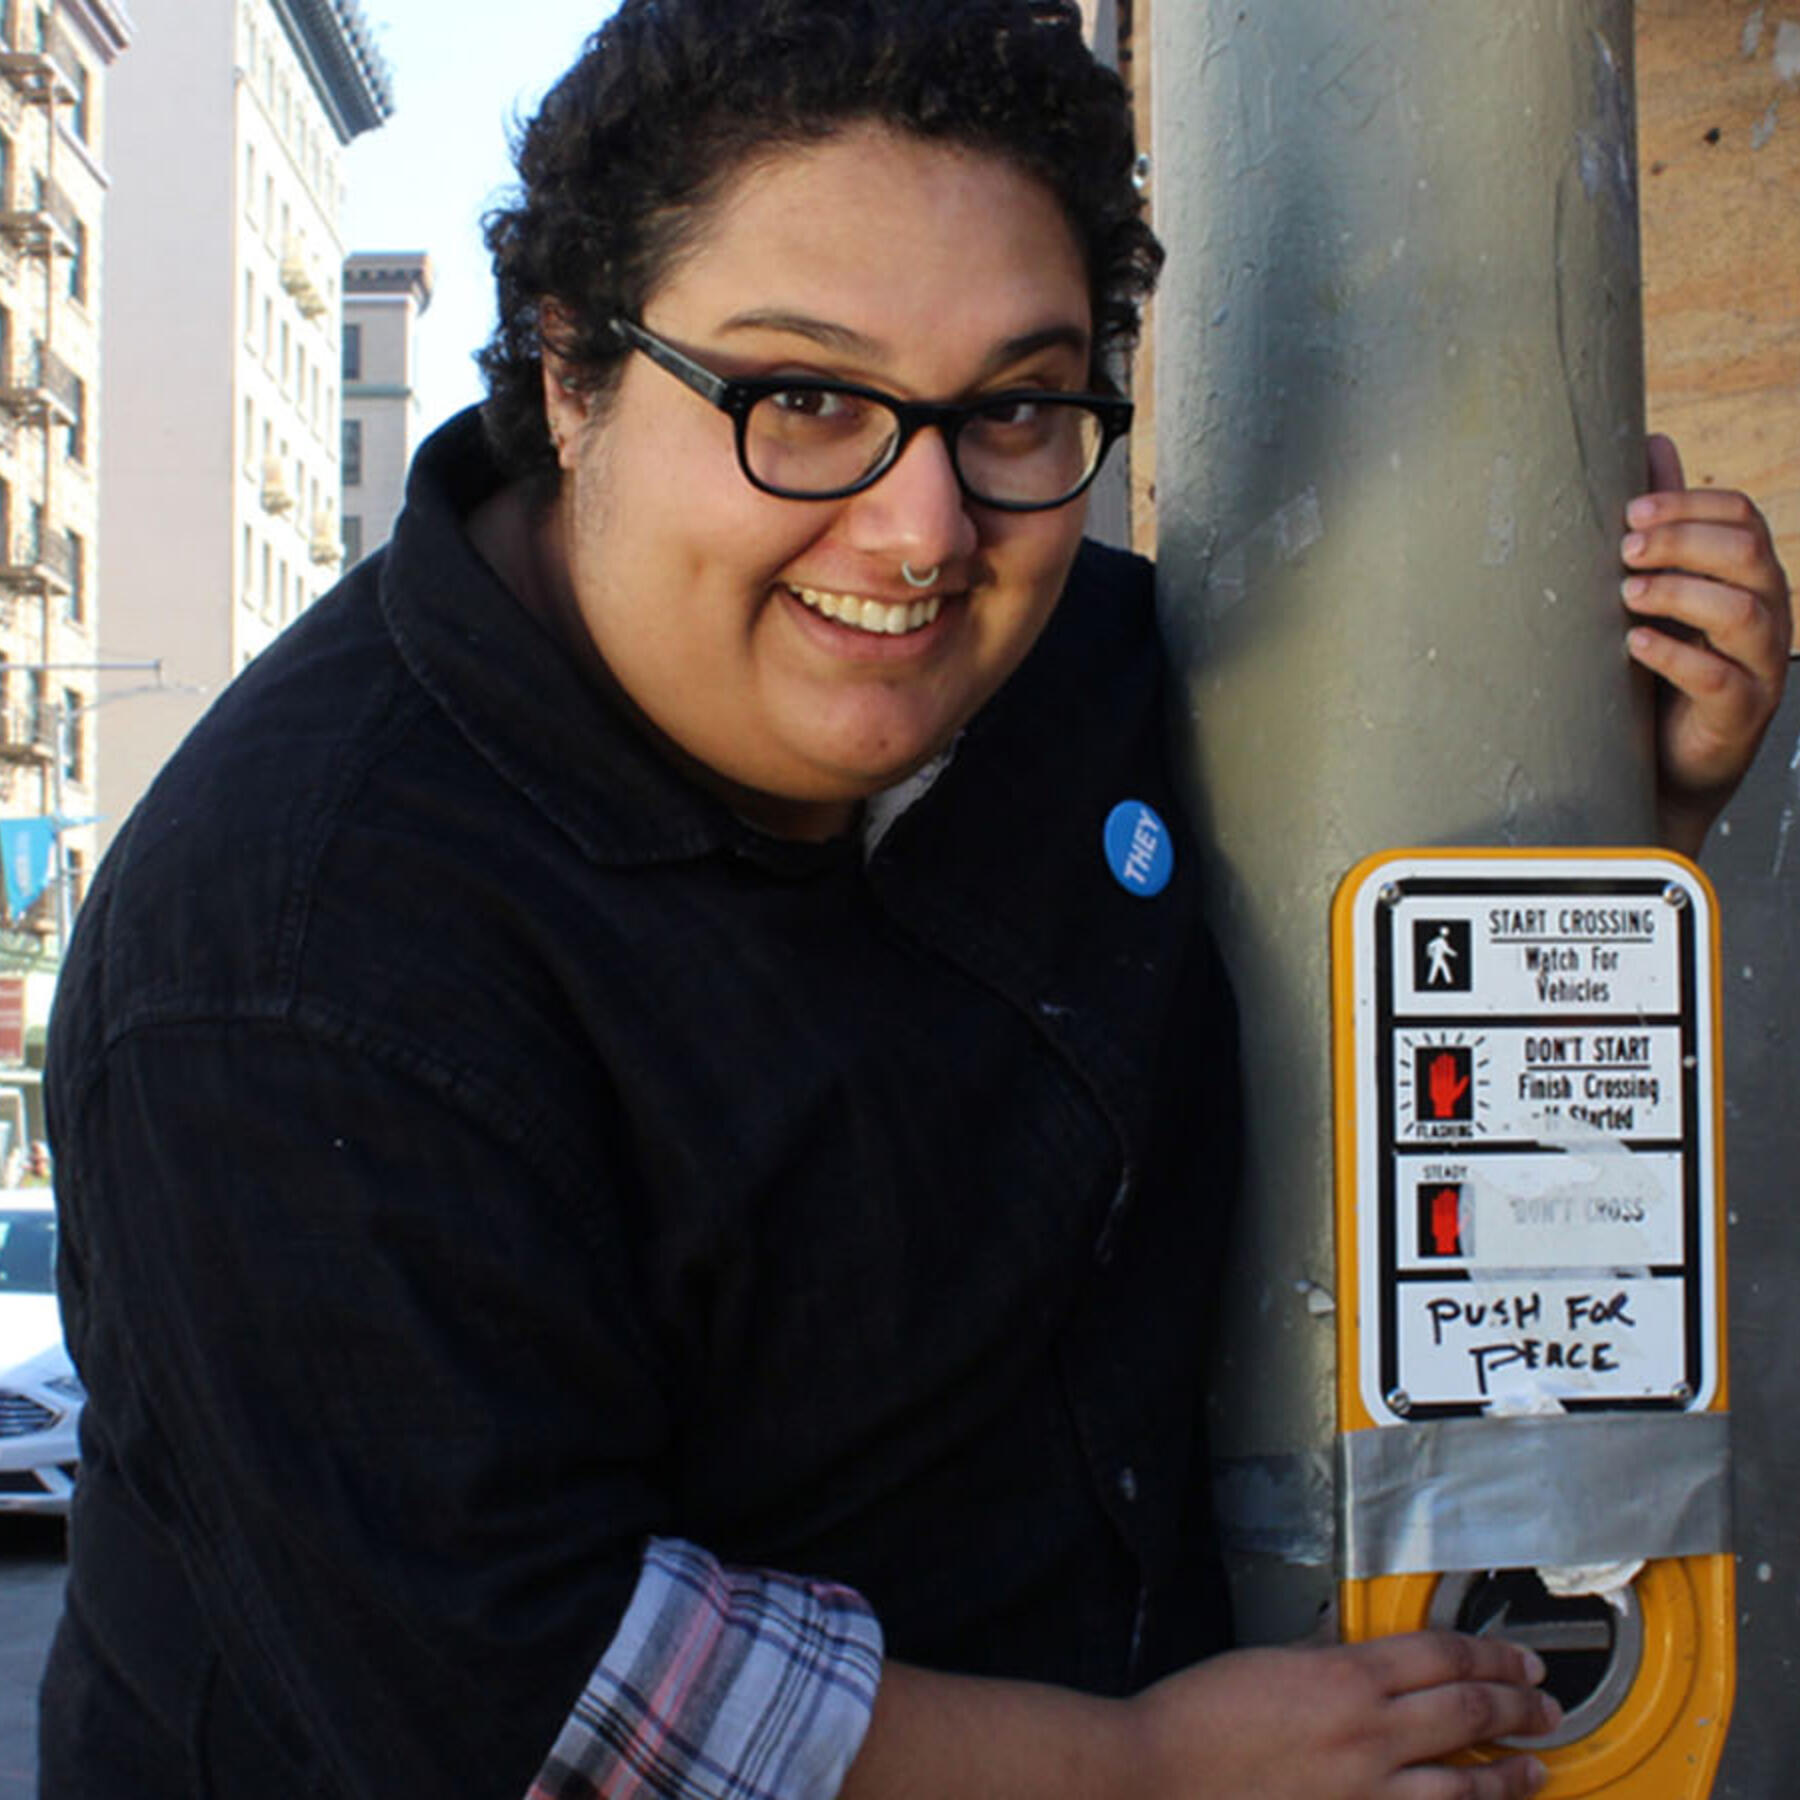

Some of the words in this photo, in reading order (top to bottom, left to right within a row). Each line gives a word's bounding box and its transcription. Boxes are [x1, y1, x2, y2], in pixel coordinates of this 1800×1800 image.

[1124, 807, 1159, 884] THEY
[1489, 909, 1546, 934] START
[1559, 909, 1655, 934] CROSSING
[1525, 947, 1579, 971] Watch
[1592, 947, 1619, 971] For
[1536, 977, 1610, 1002] Vehicles
[1525, 1037, 1583, 1062] DON'T
[1593, 1036, 1651, 1061] START
[1519, 1073, 1572, 1099] Finish
[1584, 1074, 1659, 1104] Crossing
[1417, 1125, 1473, 1138] FLASHING
[1423, 1164, 1468, 1179] STEADY
[1427, 1293, 1541, 1345] PUSH
[1565, 1292, 1635, 1330] FOR
[1469, 1340, 1620, 1396] PEACE
